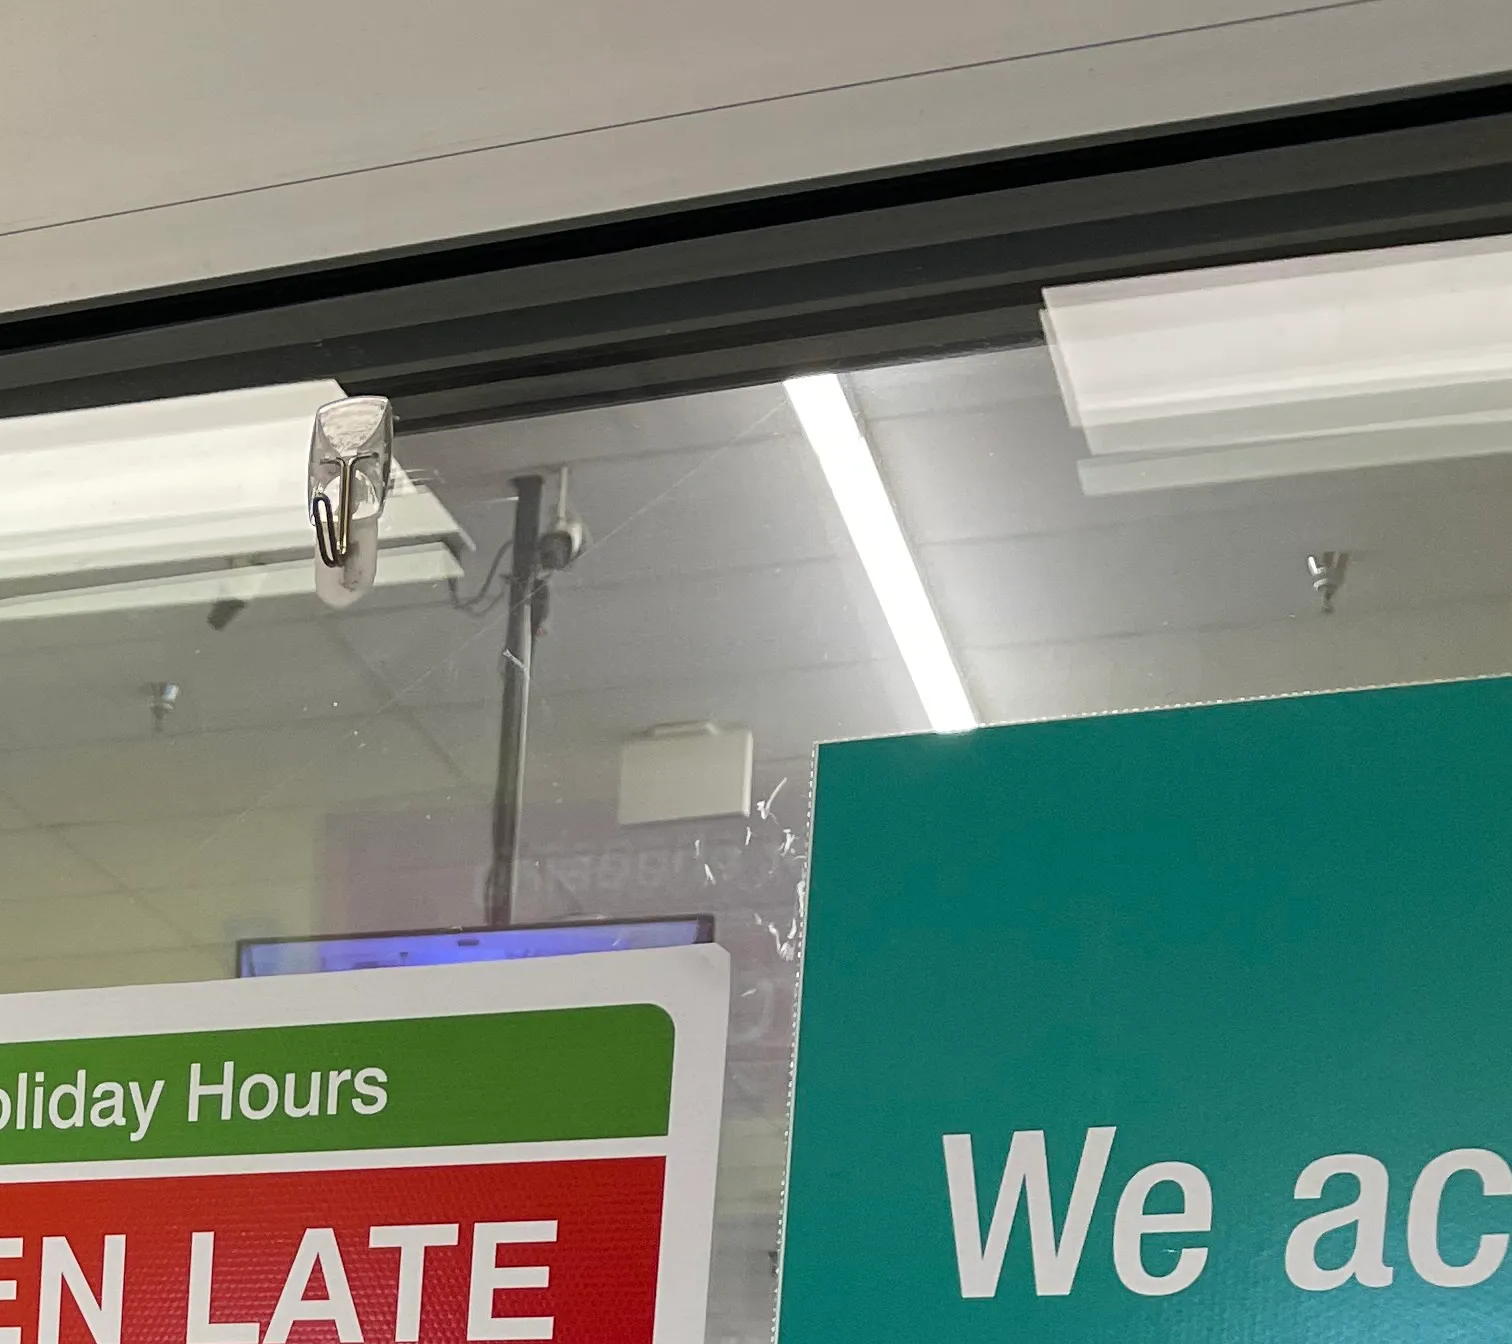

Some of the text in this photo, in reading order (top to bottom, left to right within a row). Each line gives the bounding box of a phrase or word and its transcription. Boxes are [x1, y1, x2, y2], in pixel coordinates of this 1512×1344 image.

[188, 1061, 387, 1121] Hours
[942, 1125, 1512, 1300] We ac
[186, 1221, 557, 1344] LATE
